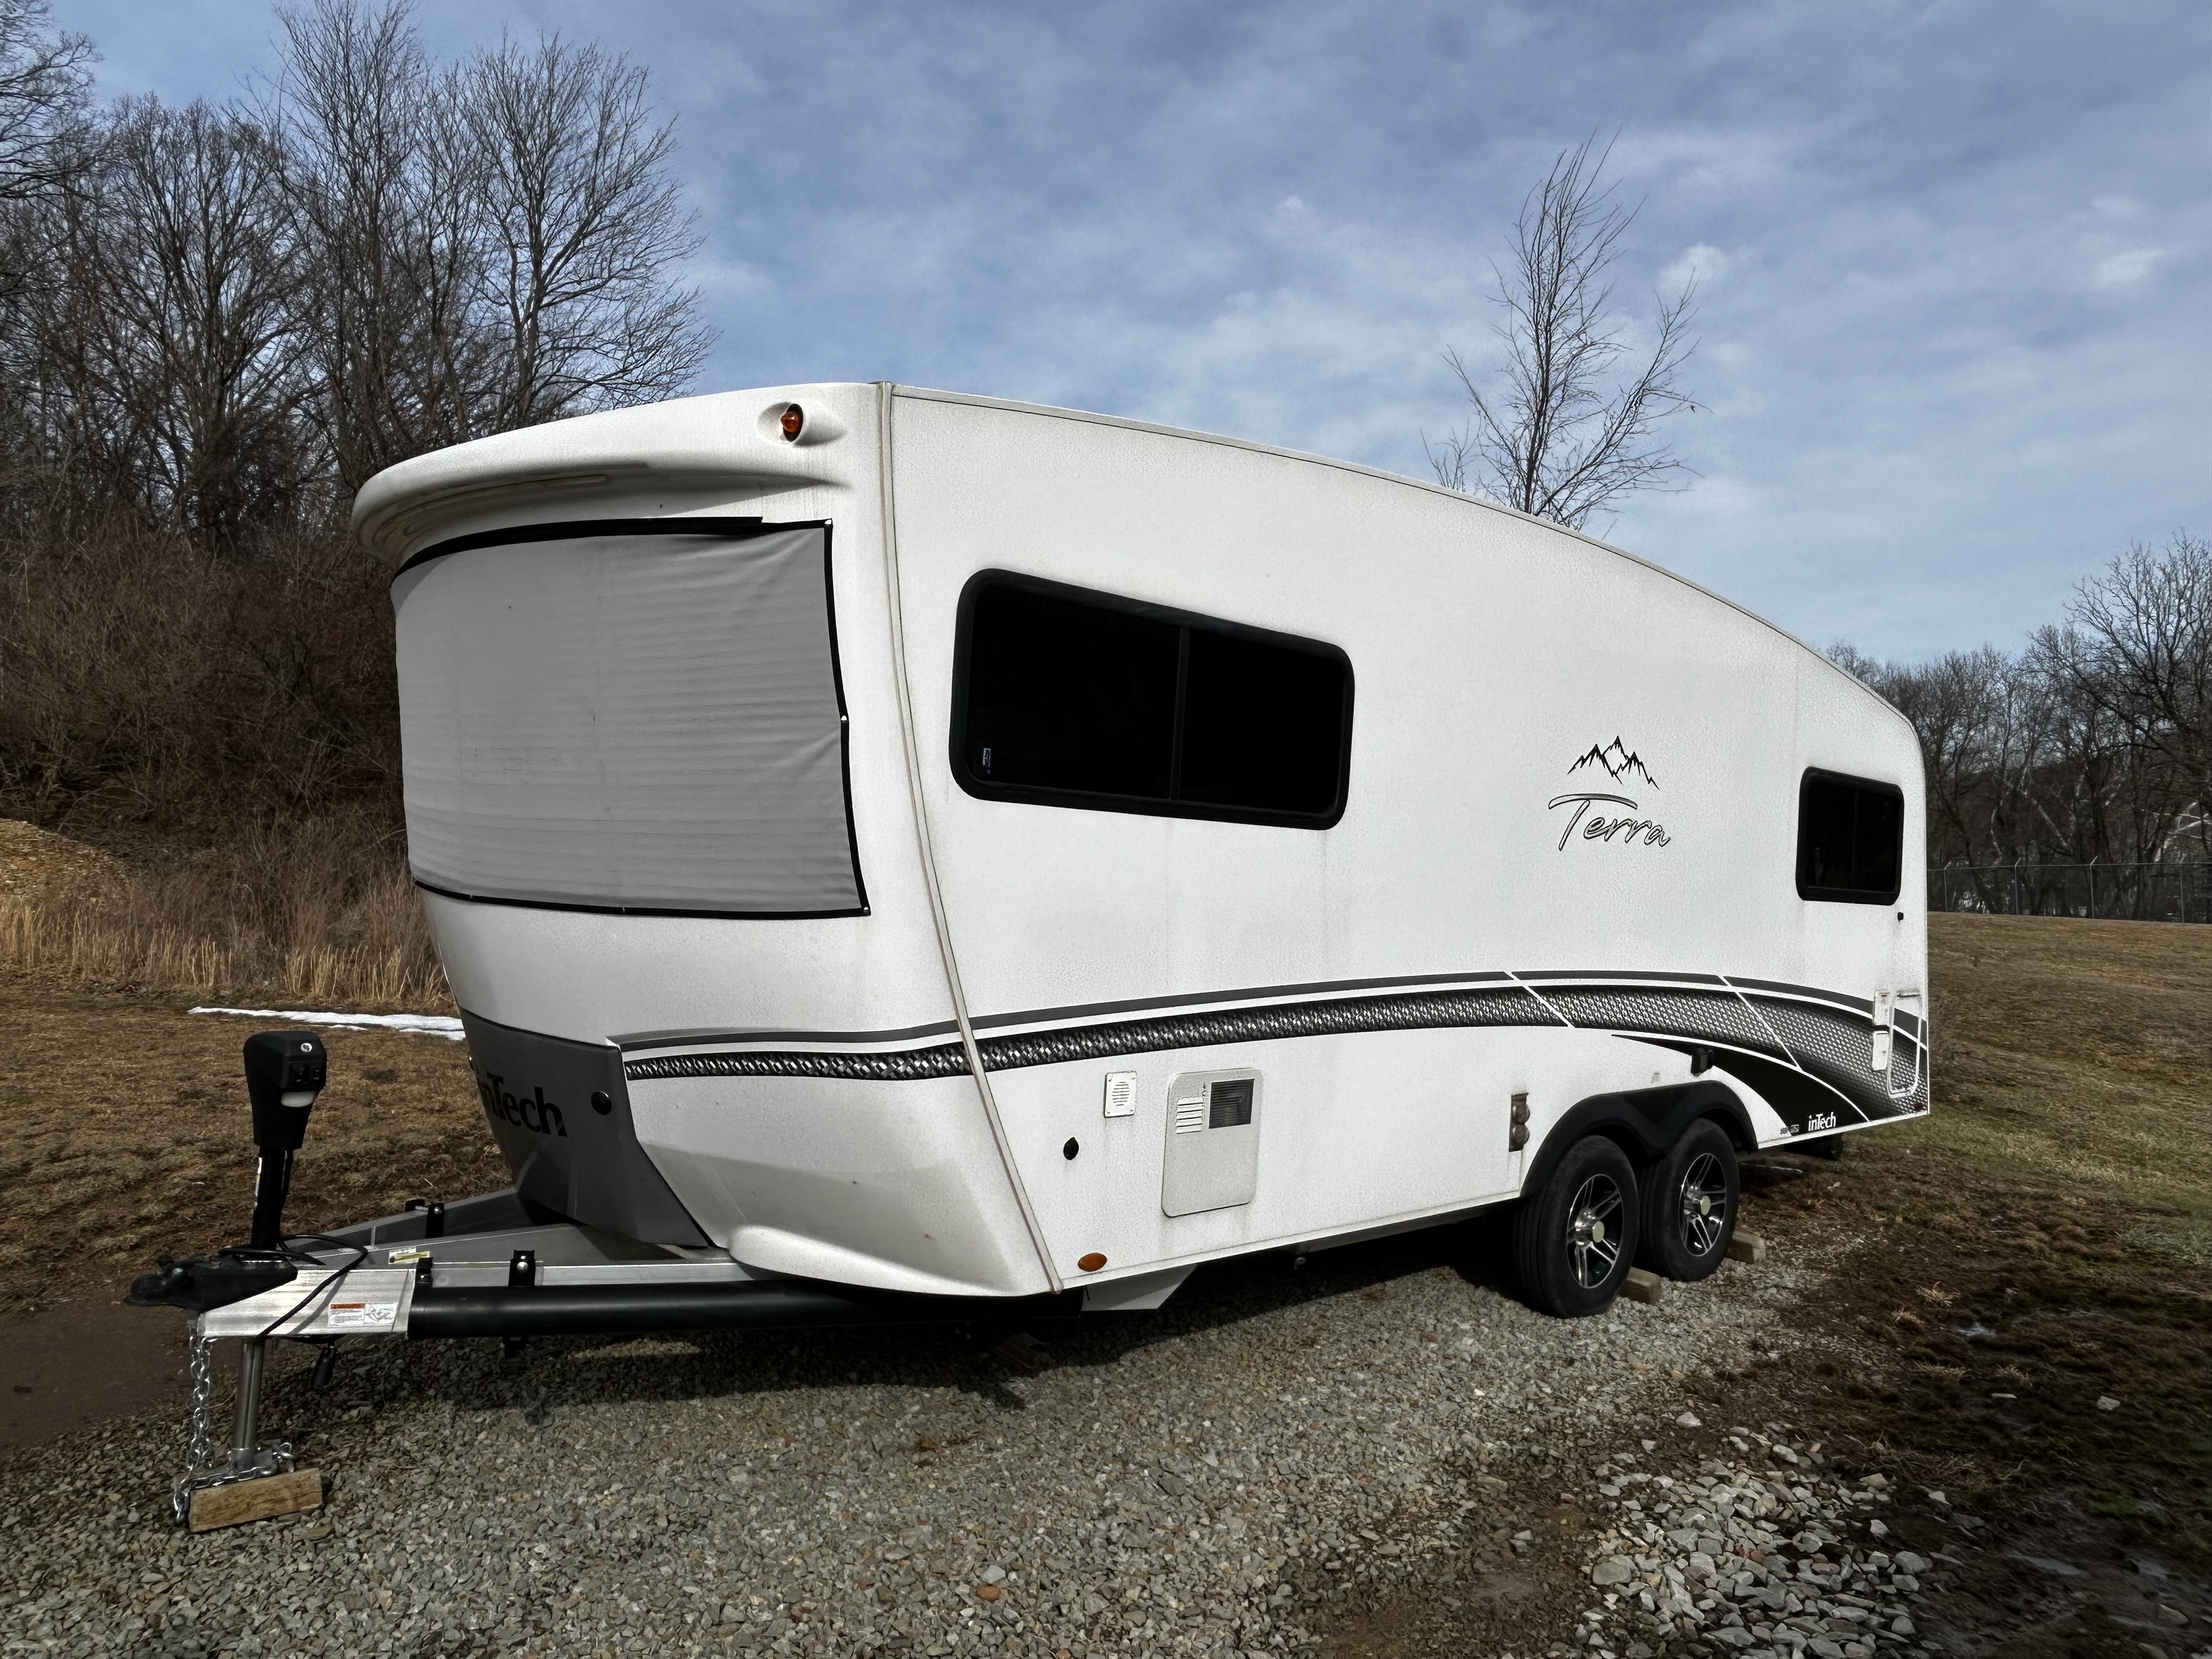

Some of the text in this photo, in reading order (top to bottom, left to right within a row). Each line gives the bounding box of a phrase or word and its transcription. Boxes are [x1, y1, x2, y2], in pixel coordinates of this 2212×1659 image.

[1548, 793, 1671, 851] Terra
[476, 1068, 568, 1137] nTech
[1808, 1111, 1836, 1131] inTech
